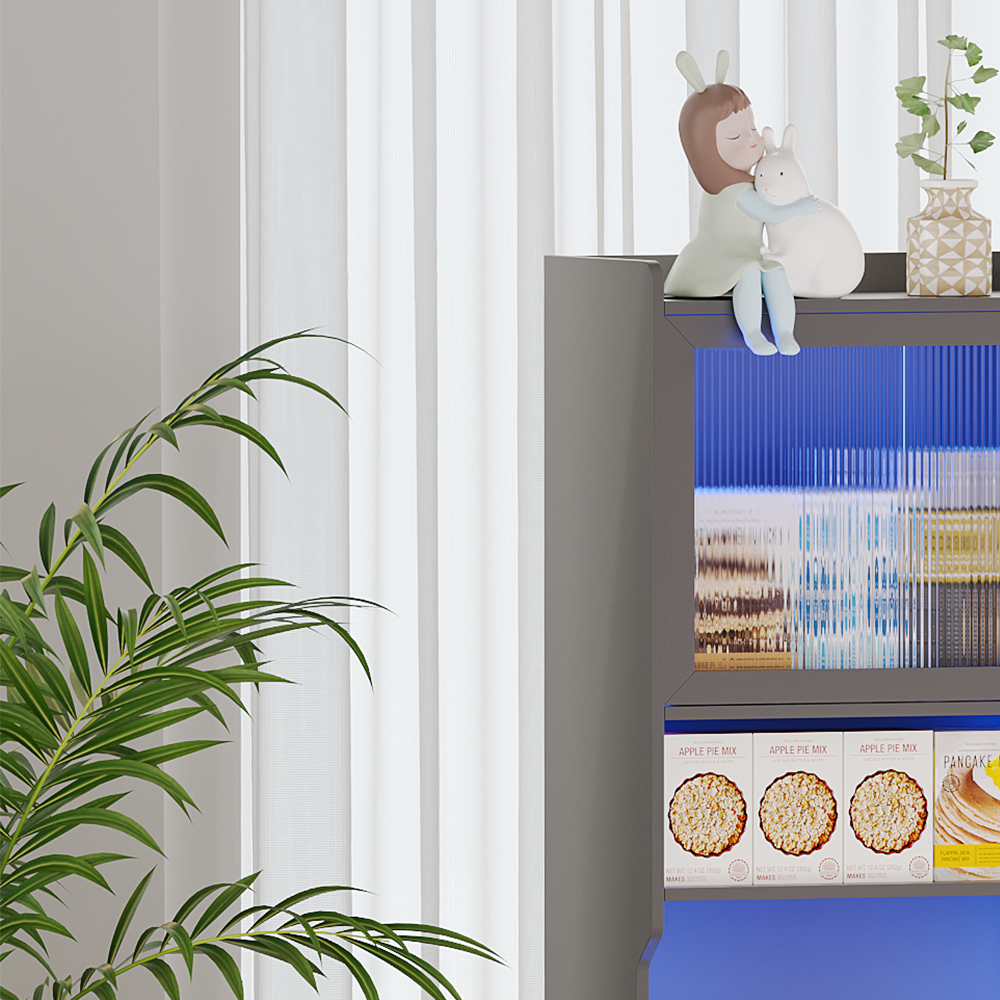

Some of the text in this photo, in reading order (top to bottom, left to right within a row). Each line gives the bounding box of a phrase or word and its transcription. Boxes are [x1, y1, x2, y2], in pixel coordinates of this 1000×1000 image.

[679, 746, 736, 756] APPLE PIE MIX
[770, 745, 827, 754] APPLE PIE MIX
[860, 744, 918, 753] APPLE PIE MIX
[944, 755, 992, 768] PANCAKE
